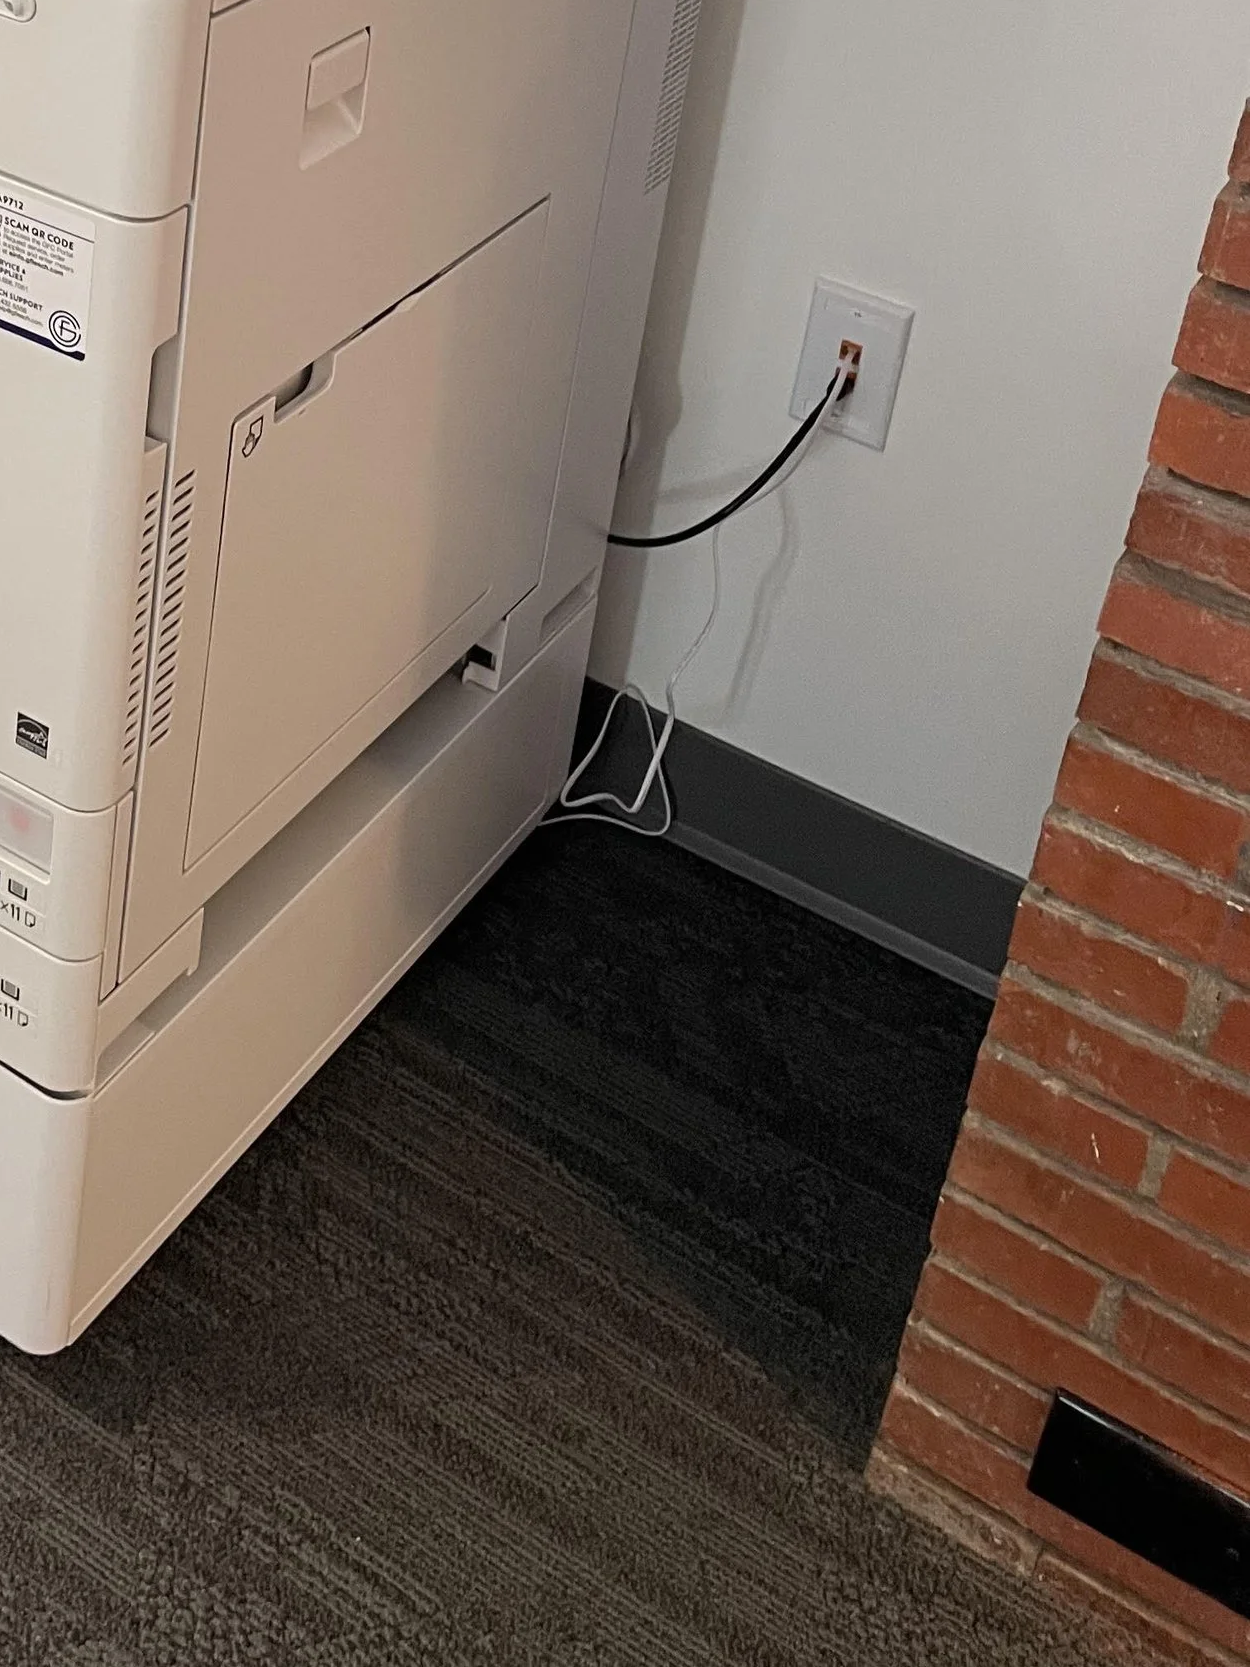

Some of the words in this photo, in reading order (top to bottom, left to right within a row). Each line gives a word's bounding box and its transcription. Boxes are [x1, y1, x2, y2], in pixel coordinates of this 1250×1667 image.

[4, 216, 30, 233] SCAN
[31, 227, 47, 239] QR
[47, 234, 74, 251] CODE
[9, 292, 43, 312] SUPPORT
